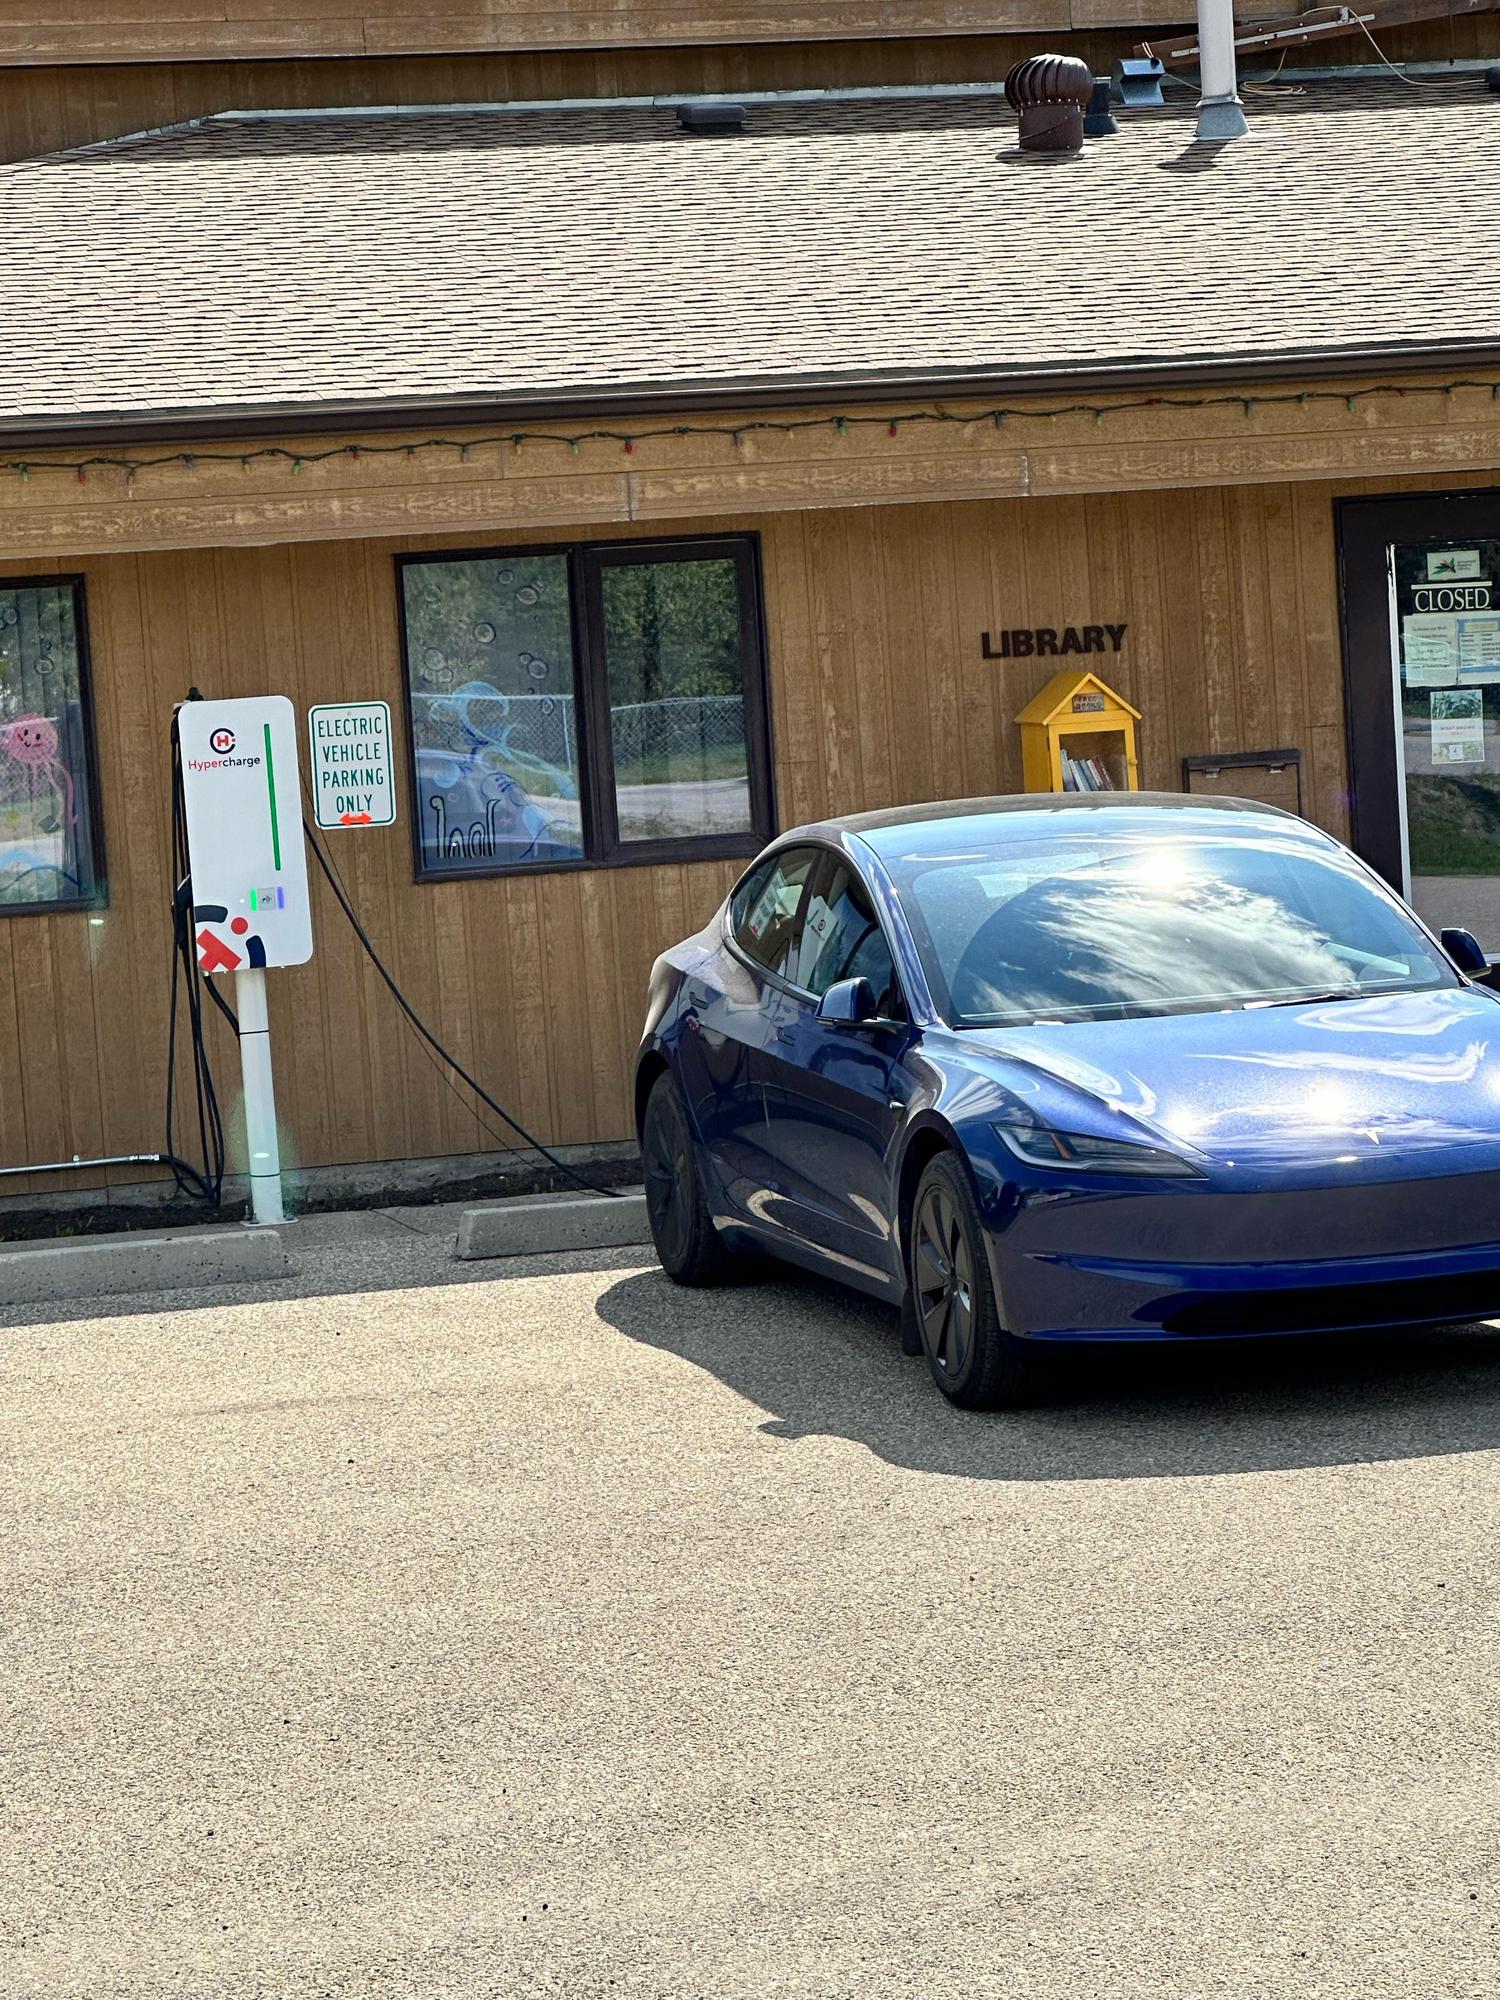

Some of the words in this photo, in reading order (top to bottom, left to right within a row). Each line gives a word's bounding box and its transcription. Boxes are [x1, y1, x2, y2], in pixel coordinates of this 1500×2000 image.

[1415, 588, 1490, 611] CLOSED
[981, 624, 1128, 659] LIBRARY
[318, 716, 383, 738] ELECTRIC
[188, 755, 261, 771] Hypercharge
[322, 742, 381, 763] VEHICLE
[323, 767, 384, 789] PARKING
[336, 794, 373, 814] ONLY
